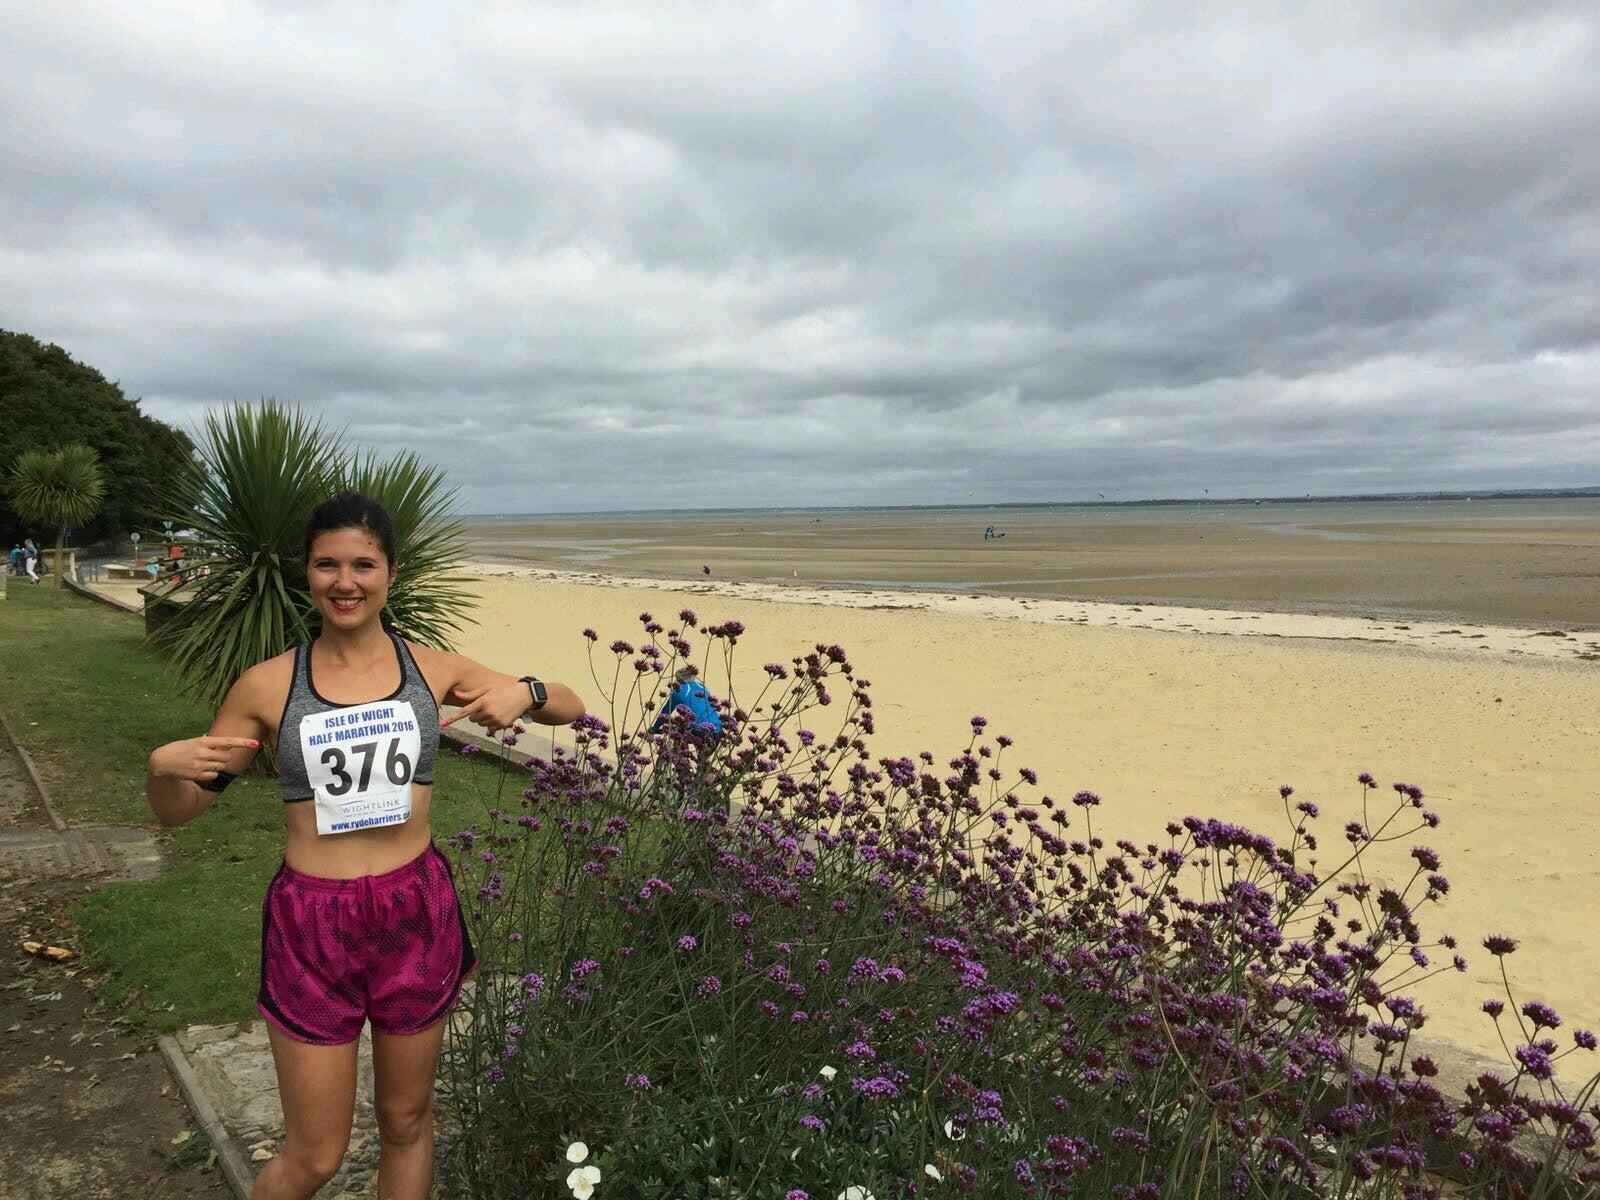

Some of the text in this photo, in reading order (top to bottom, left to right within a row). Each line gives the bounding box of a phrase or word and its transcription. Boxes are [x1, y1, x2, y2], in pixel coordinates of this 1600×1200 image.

[325, 708, 394, 729] ISLE OF WIGHT
[309, 721, 414, 746] HALF MARATHON 2016
[321, 737, 411, 796] 376
[342, 799, 400, 814] WIGHTLINK
